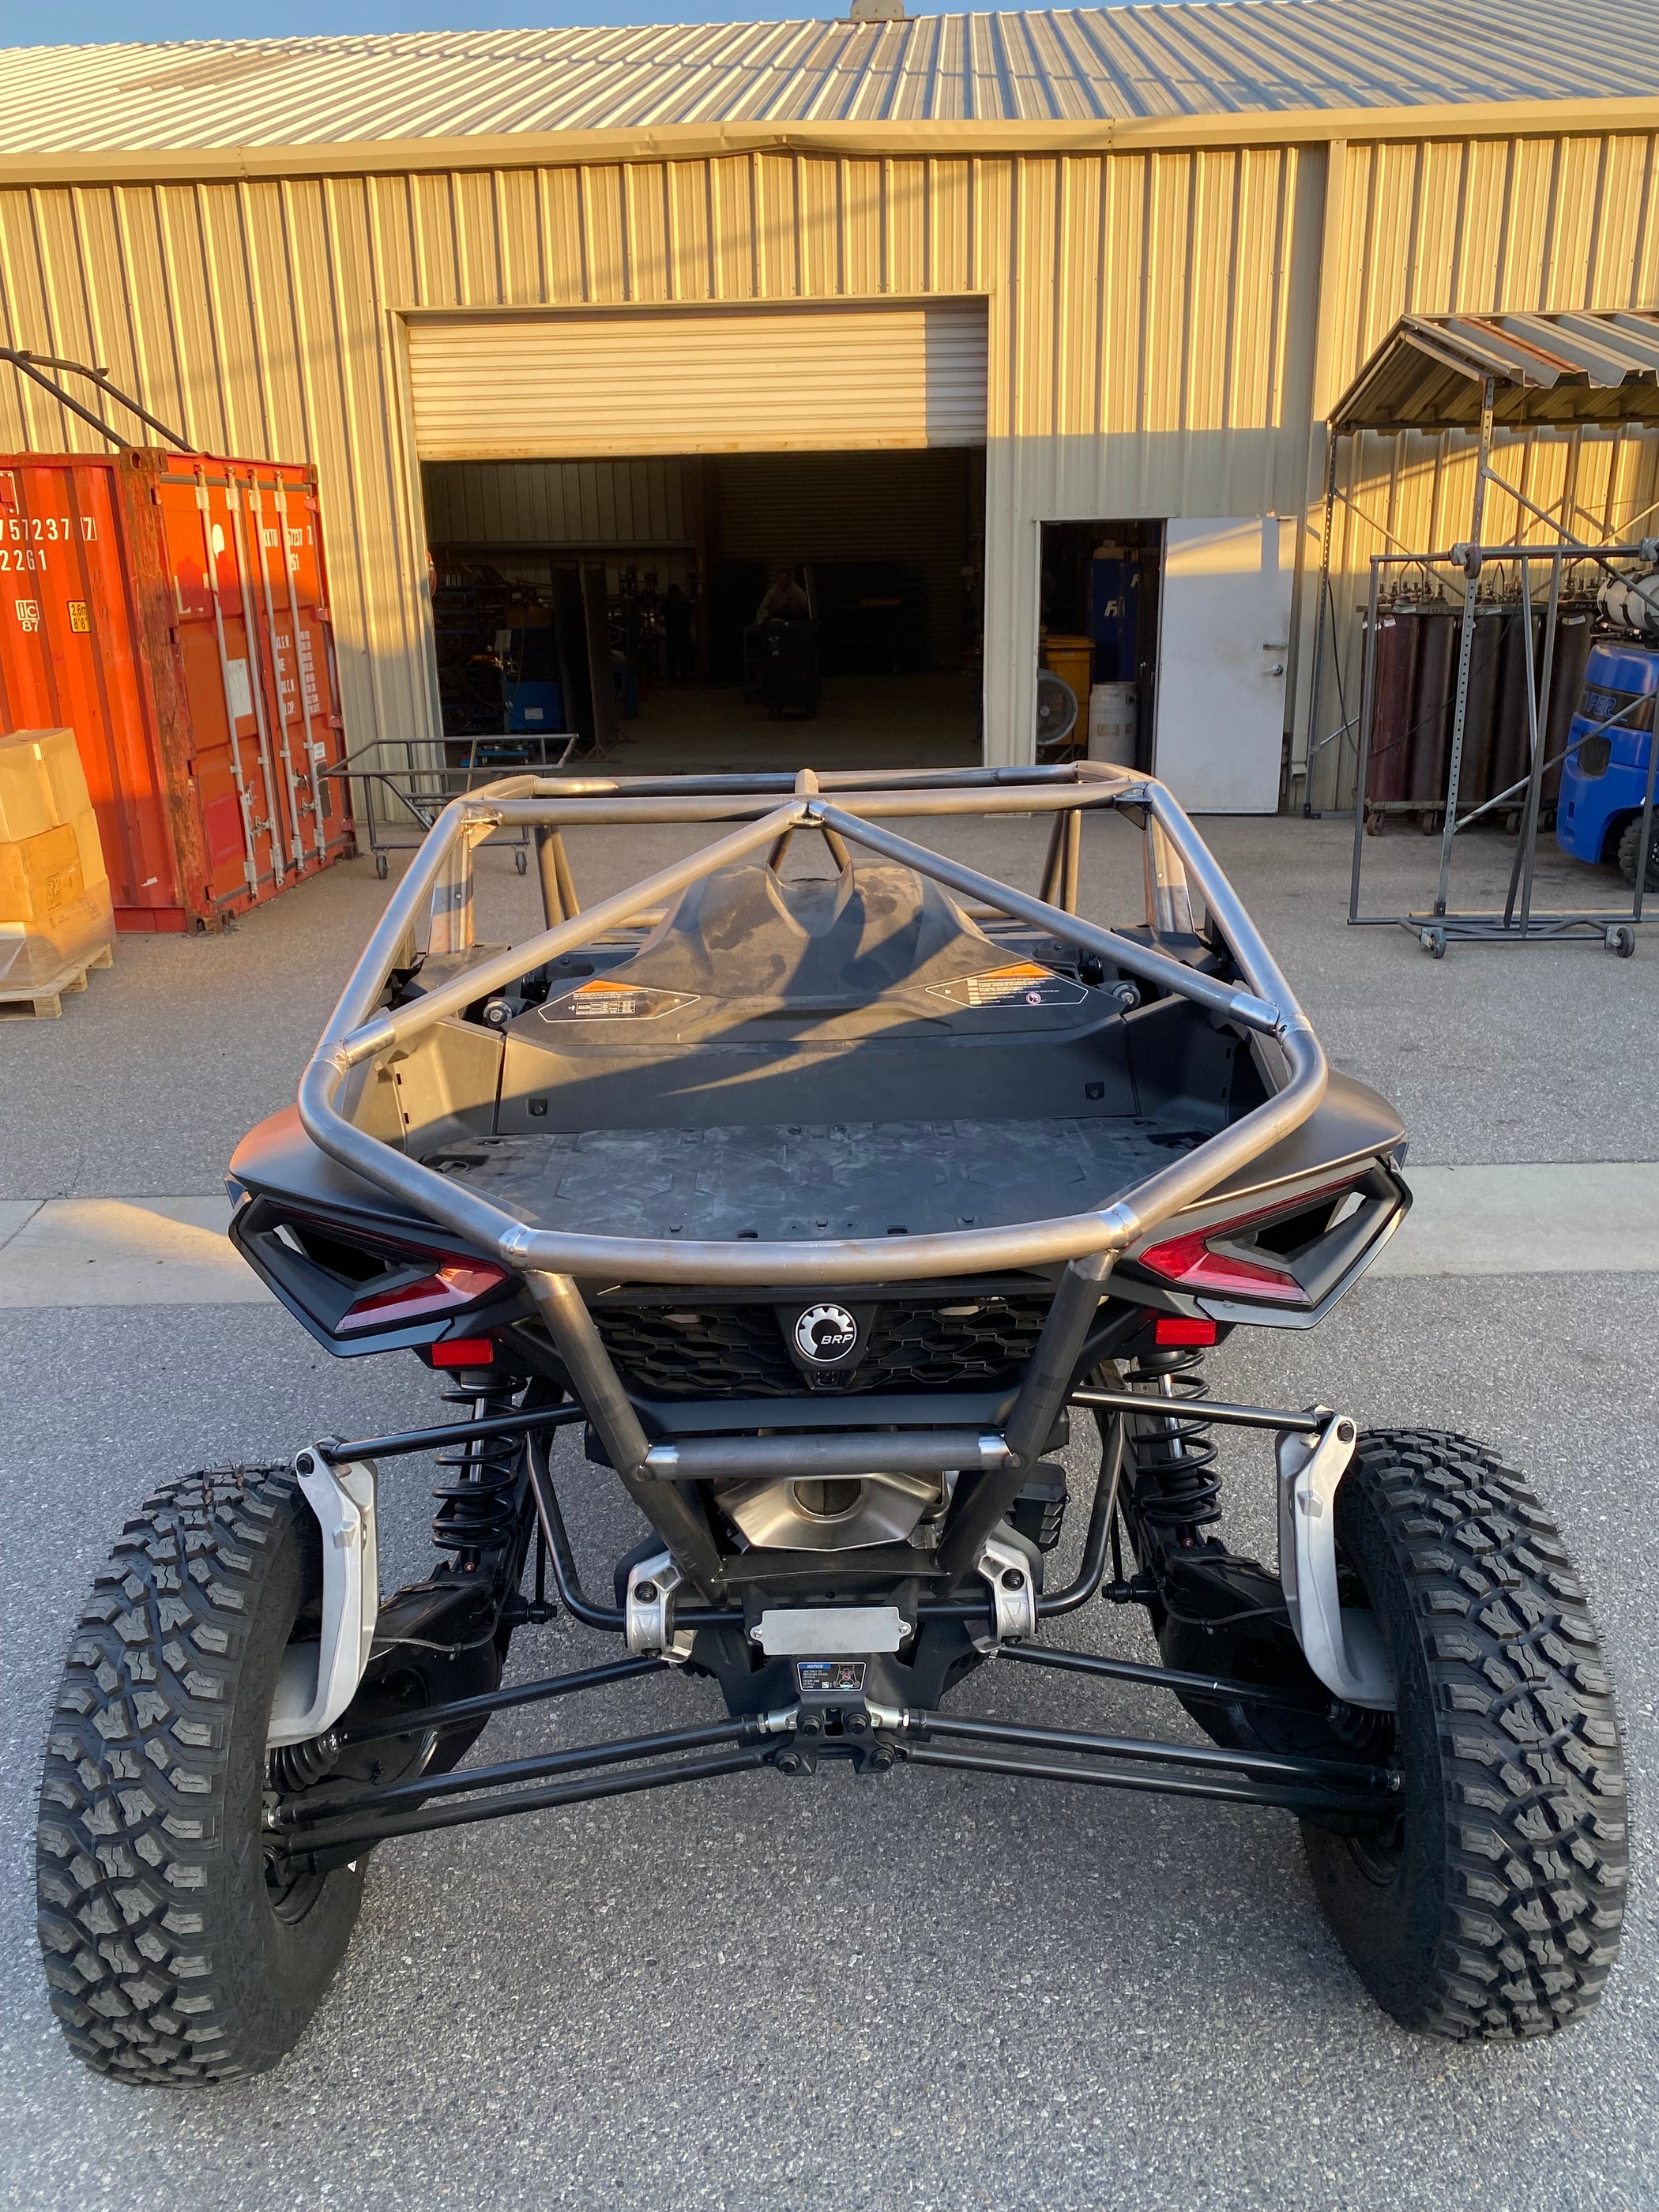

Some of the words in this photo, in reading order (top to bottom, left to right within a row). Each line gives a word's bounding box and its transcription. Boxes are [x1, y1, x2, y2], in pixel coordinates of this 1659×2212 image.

[0, 549, 47, 570] 22G1
[21, 619, 39, 632] 87
[821, 1334, 853, 1345] BRP
